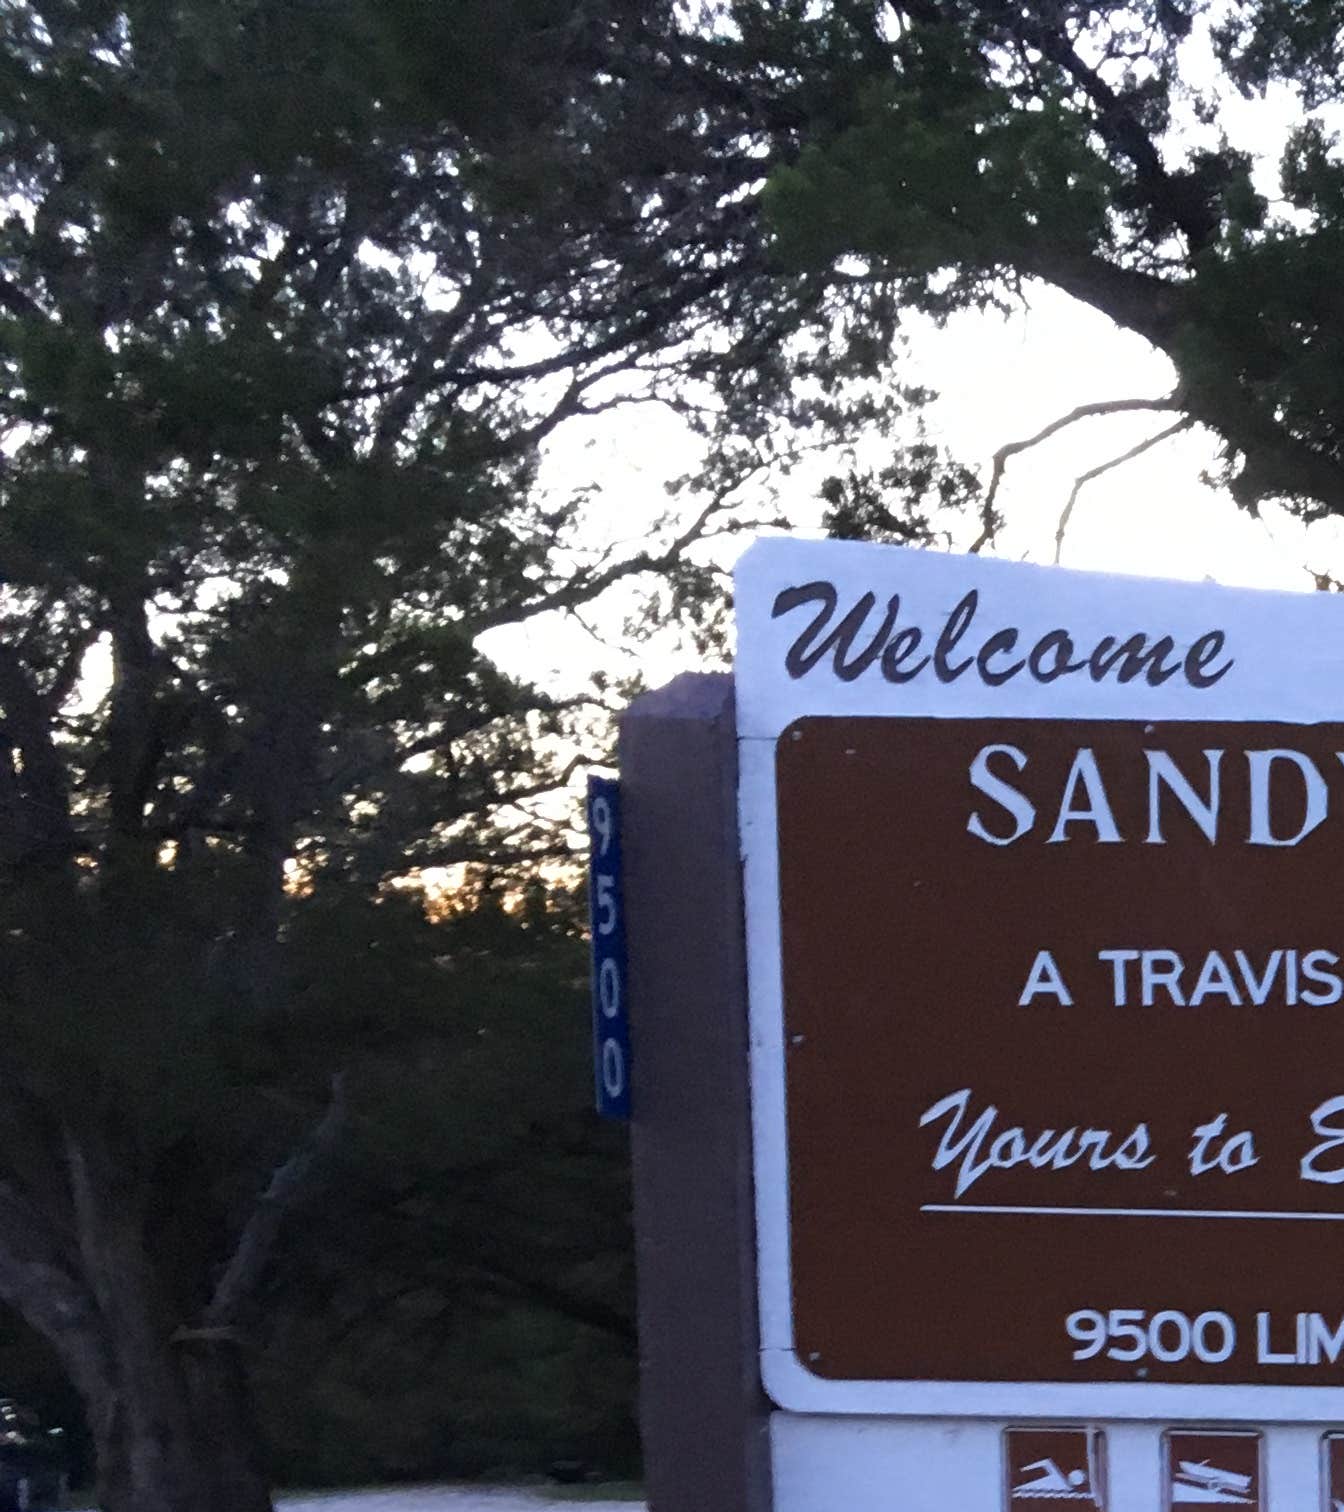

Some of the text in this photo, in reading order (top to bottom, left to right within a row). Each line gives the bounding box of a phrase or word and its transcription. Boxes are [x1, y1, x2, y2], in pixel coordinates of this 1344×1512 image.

[771, 581, 1234, 688] Welcome
[593, 797, 625, 1098] 9500
[1019, 951, 1073, 1005] A
[1099, 950, 1342, 1006] TRAVIS
[920, 1089, 1155, 1198] Yours
[1188, 1113, 1259, 1175] to
[1066, 1310, 1234, 1362] 9500
